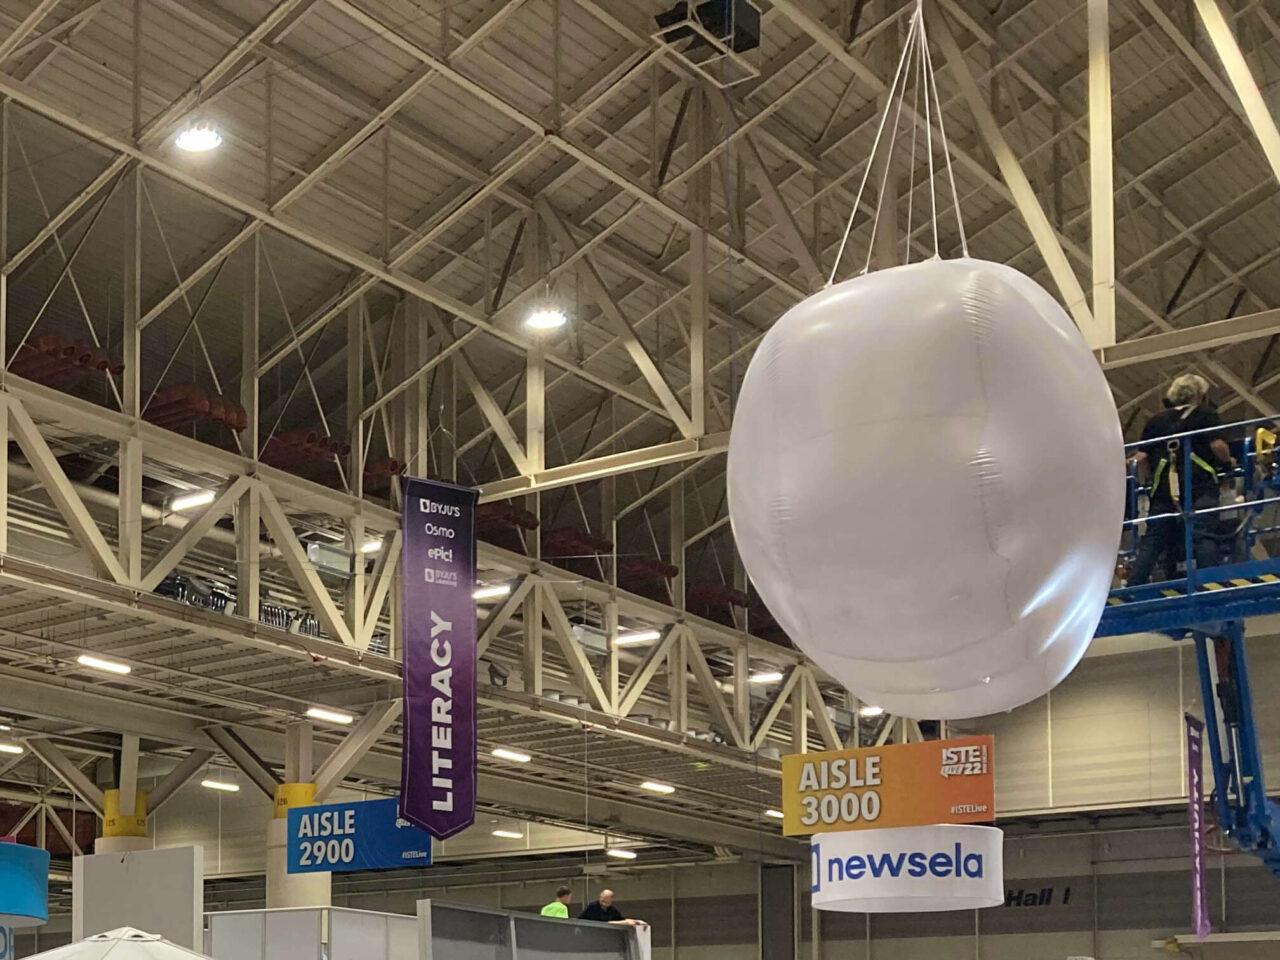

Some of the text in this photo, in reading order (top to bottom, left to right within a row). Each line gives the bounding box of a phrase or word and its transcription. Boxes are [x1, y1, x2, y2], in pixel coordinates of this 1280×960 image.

[431, 502, 460, 517] BYJU'S
[425, 523, 455, 539] Osmo
[430, 610, 454, 812] LITERACY
[942, 746, 982, 765] ISTE
[799, 756, 881, 792] AISLE
[801, 791, 880, 825] 3000
[298, 810, 356, 838] AISLE
[299, 838, 355, 866] 2900
[828, 843, 983, 882] newsela
[1005, 889, 1053, 908] Hall
